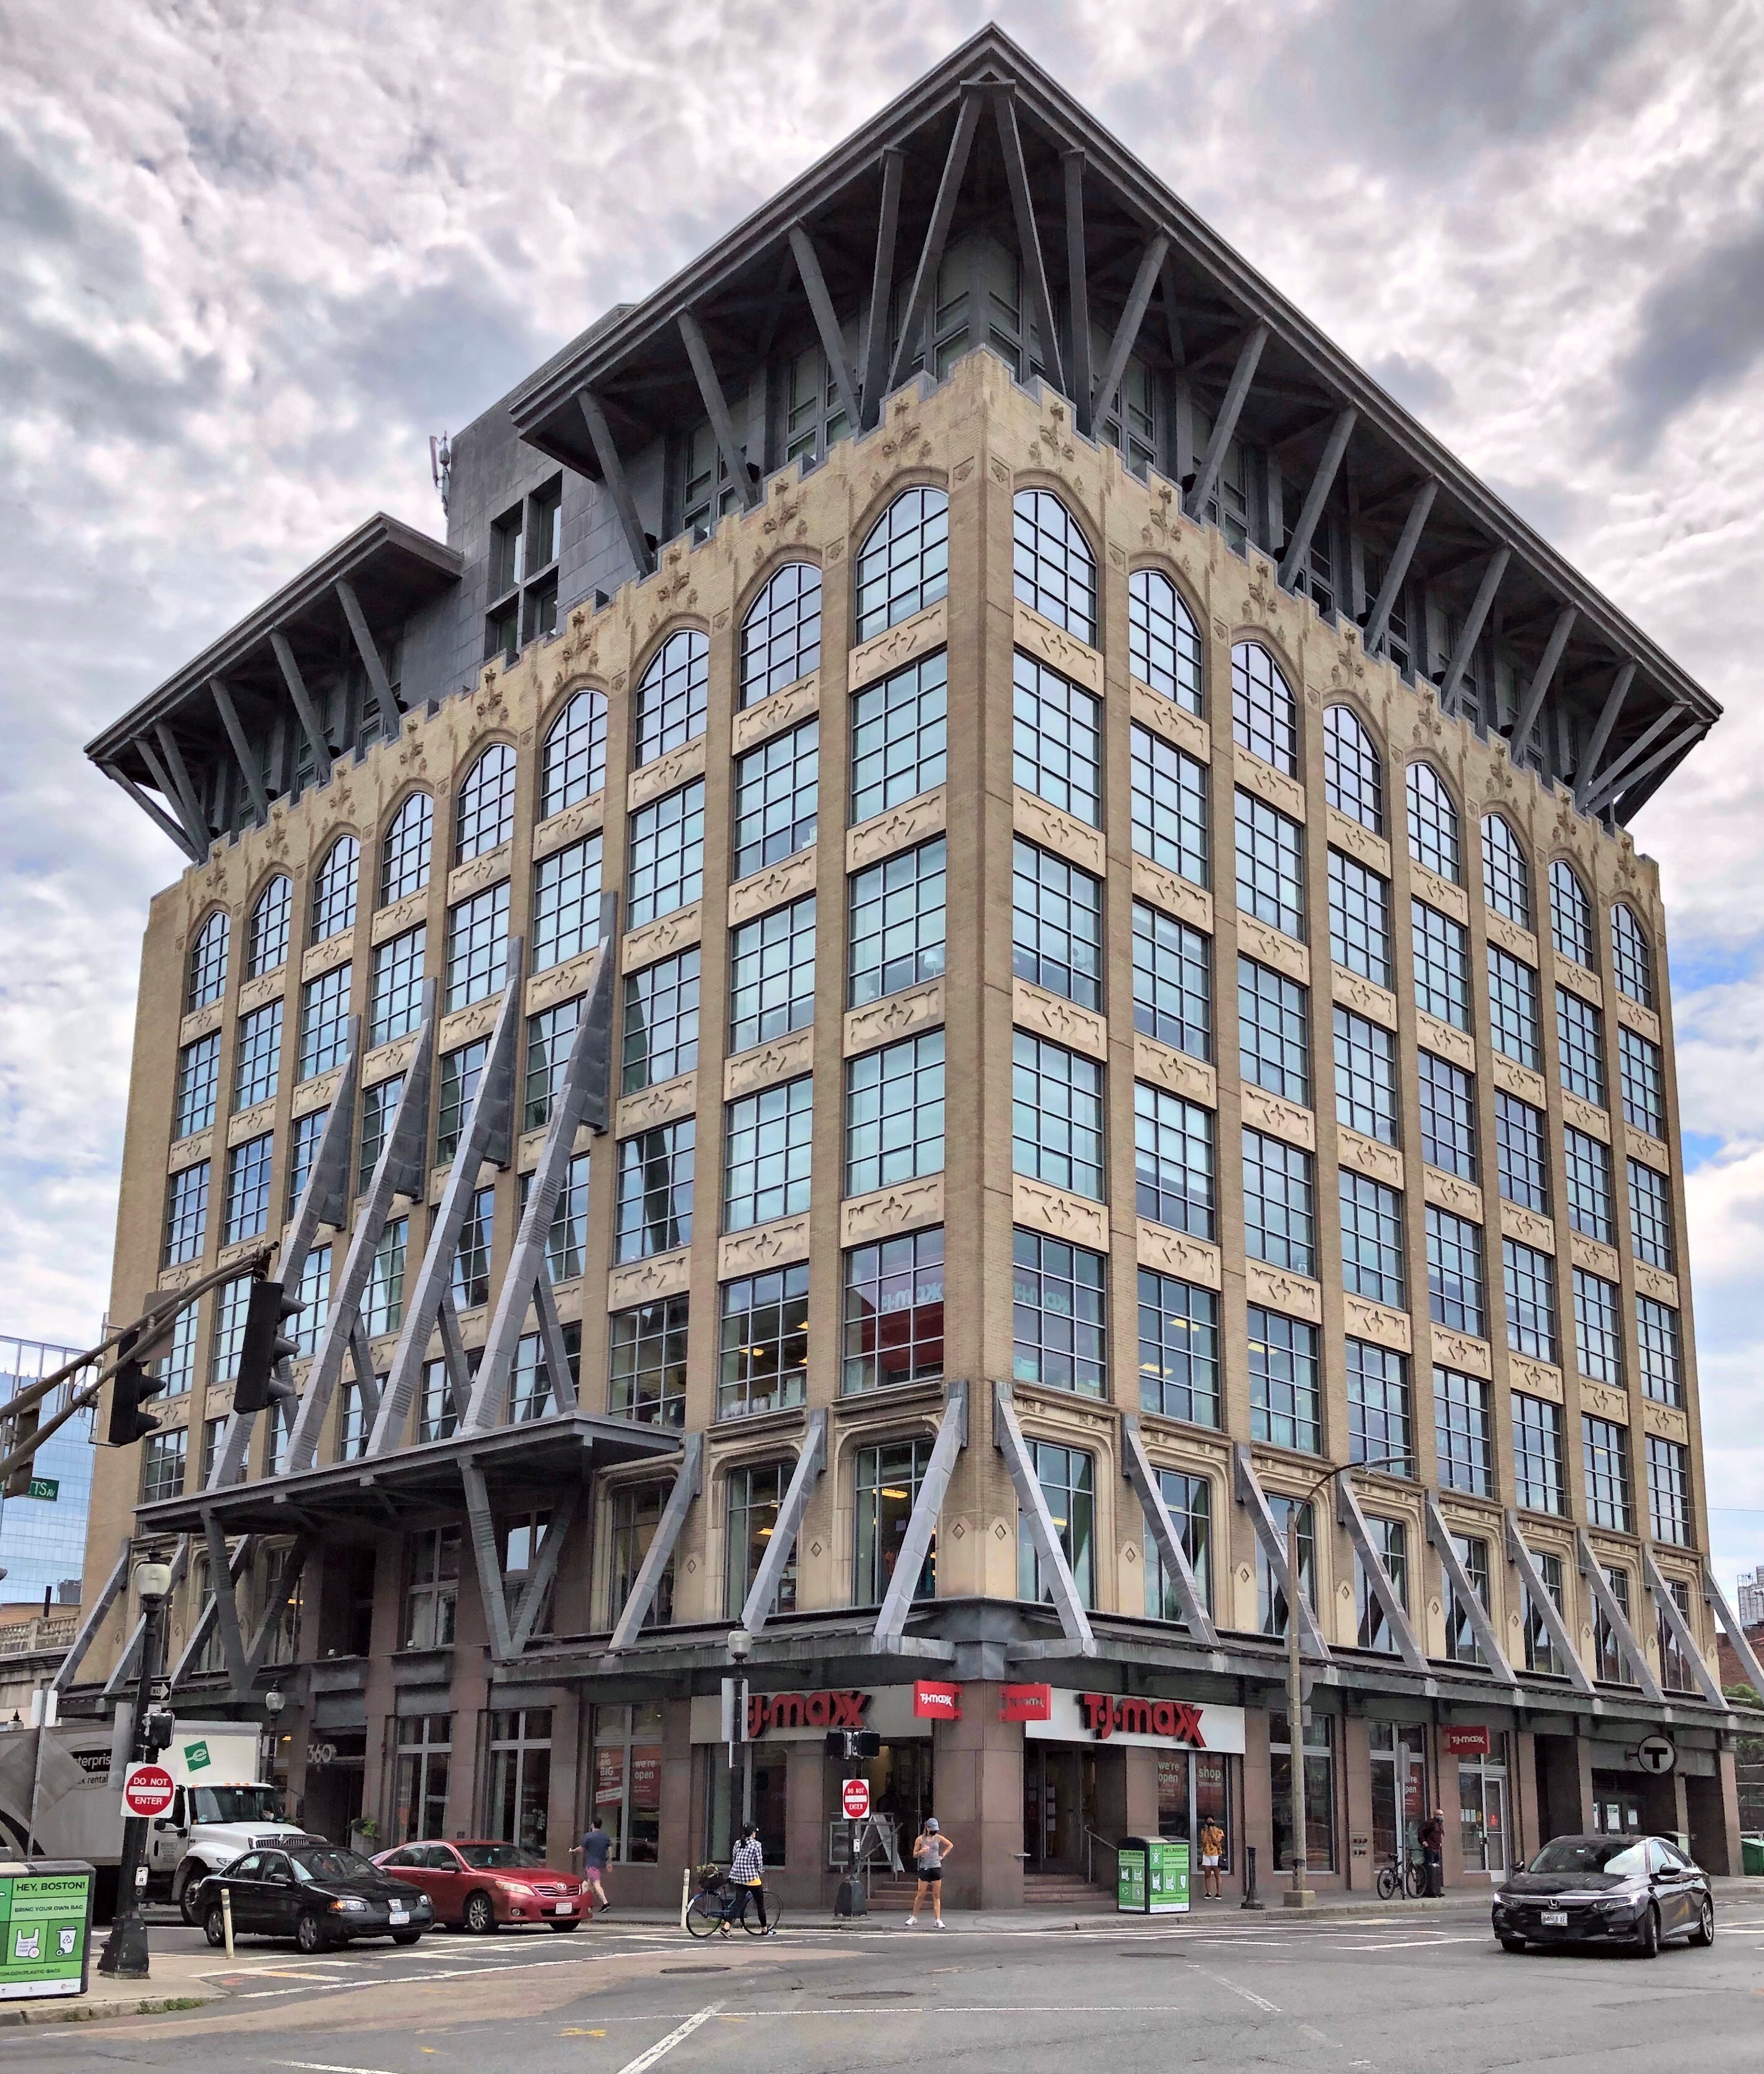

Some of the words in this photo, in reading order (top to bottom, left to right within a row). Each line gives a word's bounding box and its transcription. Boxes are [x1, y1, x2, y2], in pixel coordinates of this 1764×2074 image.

[307, 1744, 332, 1763] 360
[1644, 1746, 1668, 1769] T
[634, 1760, 656, 1768] we're
[1158, 1761, 1179, 1771] we're
[600, 1766, 613, 1776] BIG
[634, 1771, 654, 1781] open
[1198, 1766, 1221, 1781] shop
[88, 1773, 108, 1784] rental
[133, 1777, 146, 1785] DO
[150, 1778, 169, 1786] NOT
[1158, 1774, 1178, 1784] open
[1404, 1785, 1417, 1795] pen
[134, 1797, 162, 1805] ENTER
[16, 1883, 37, 1892] HEY,
[40, 1881, 85, 1891] BOSTON!
